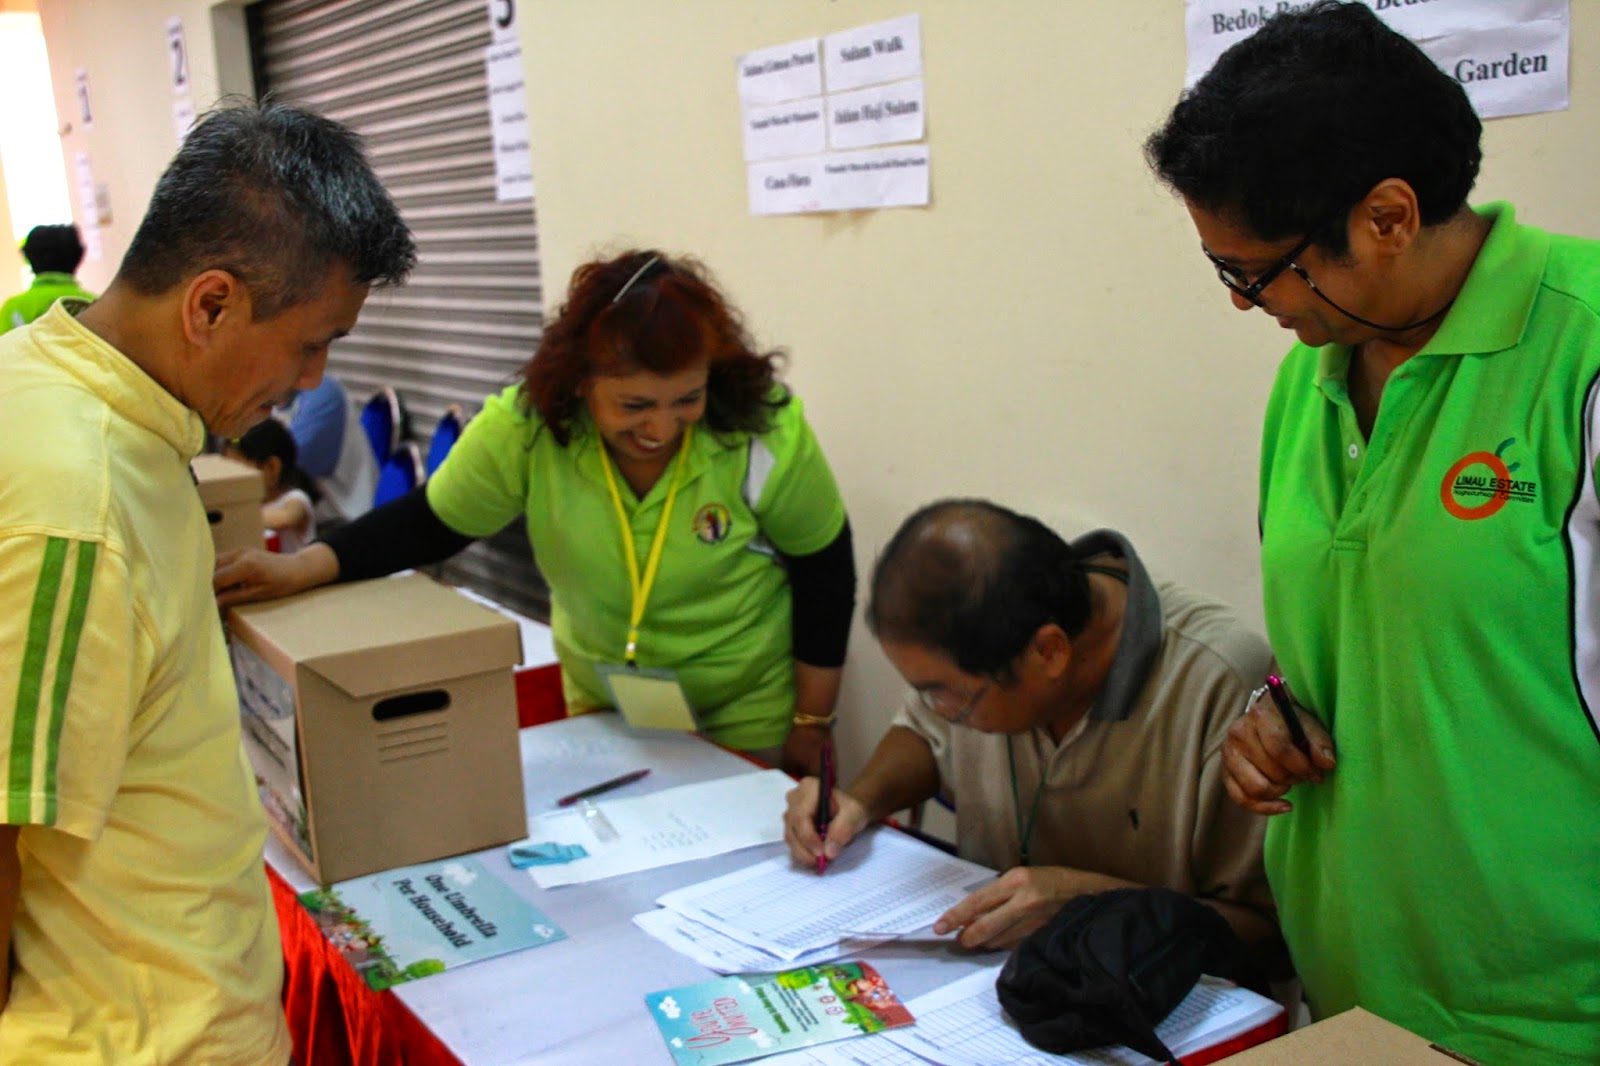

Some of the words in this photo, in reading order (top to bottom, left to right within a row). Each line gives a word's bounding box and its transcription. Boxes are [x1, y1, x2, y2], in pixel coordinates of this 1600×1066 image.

[1212, 6, 1271, 35] Bedok
[1455, 50, 1549, 84] Garden
[1456, 476, 1487, 487] LIMAU
[1489, 477, 1536, 493] ESTATE
[392, 877, 416, 895] Per
[408, 894, 474, 949] Household
[425, 873, 448, 893] One
[444, 891, 498, 939] Umbrella
